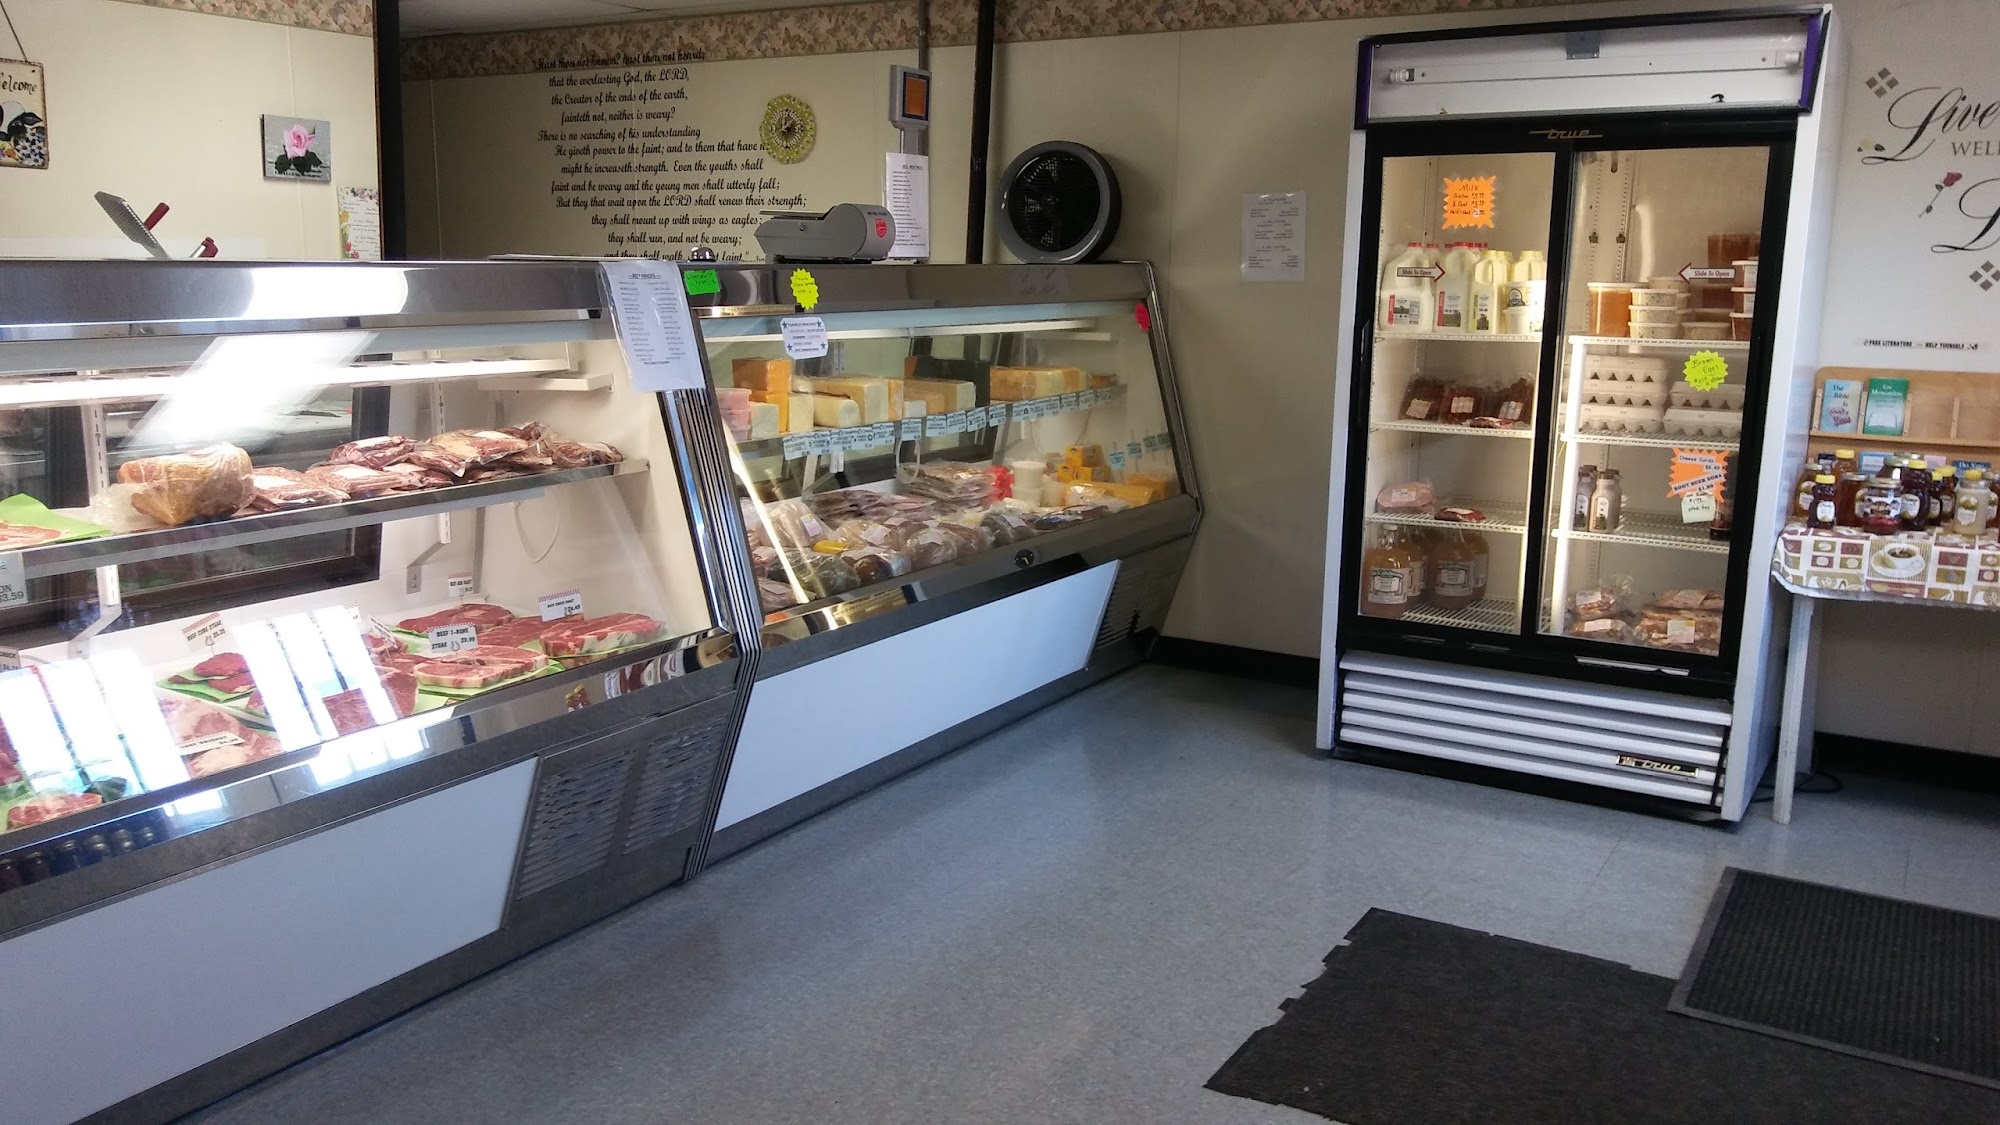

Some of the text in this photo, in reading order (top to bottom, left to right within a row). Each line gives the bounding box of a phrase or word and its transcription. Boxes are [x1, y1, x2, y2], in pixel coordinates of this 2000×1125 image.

[643, 51, 660, 63] thou
[662, 51, 676, 61] not
[0, 72, 37, 95] elcome
[549, 67, 689, 87] that the everlasting God, the LORD,
[551, 87, 688, 106] the Creator of the ends of the earth,
[561, 106, 675, 126] fainteth not, neither is weary?
[537, 126, 700, 142] There is no searching of his understanding
[1862, 87, 2000, 166] Live
[555, 145, 566, 156] He
[569, 144, 591, 159] giveth
[593, 148, 616, 158] power
[618, 145, 625, 156] to
[628, 143, 639, 154] the
[641, 142, 664, 157] faint;
[667, 141, 683, 153] and
[685, 143, 692, 152] to
[695, 141, 714, 152] them
[718, 140, 734, 151] that
[738, 140, 757, 150] have
[561, 158, 763, 176] might he increaseth strength. Even the youths shall
[551, 177, 780, 194] faint and be weary and the young men shall utterly fall;
[556, 194, 806, 210] But they that wait upon the LORD shall renew their strength;
[592, 214, 607, 228] they
[610, 213, 630, 225] shall
[632, 215, 656, 225] mount
[658, 217, 669, 228] up
[672, 214, 690, 225] with
[692, 215, 716, 228] wings
[719, 217, 728, 225] as
[608, 232, 742, 248] they shall run, and not be weary;
[1691, 478, 1707, 487] BEER
[1706, 474, 1723, 482] SODA
[187, 632, 196, 641] BEEF
[209, 620, 222, 630] STEAK
[432, 642, 447, 650] STEAK
